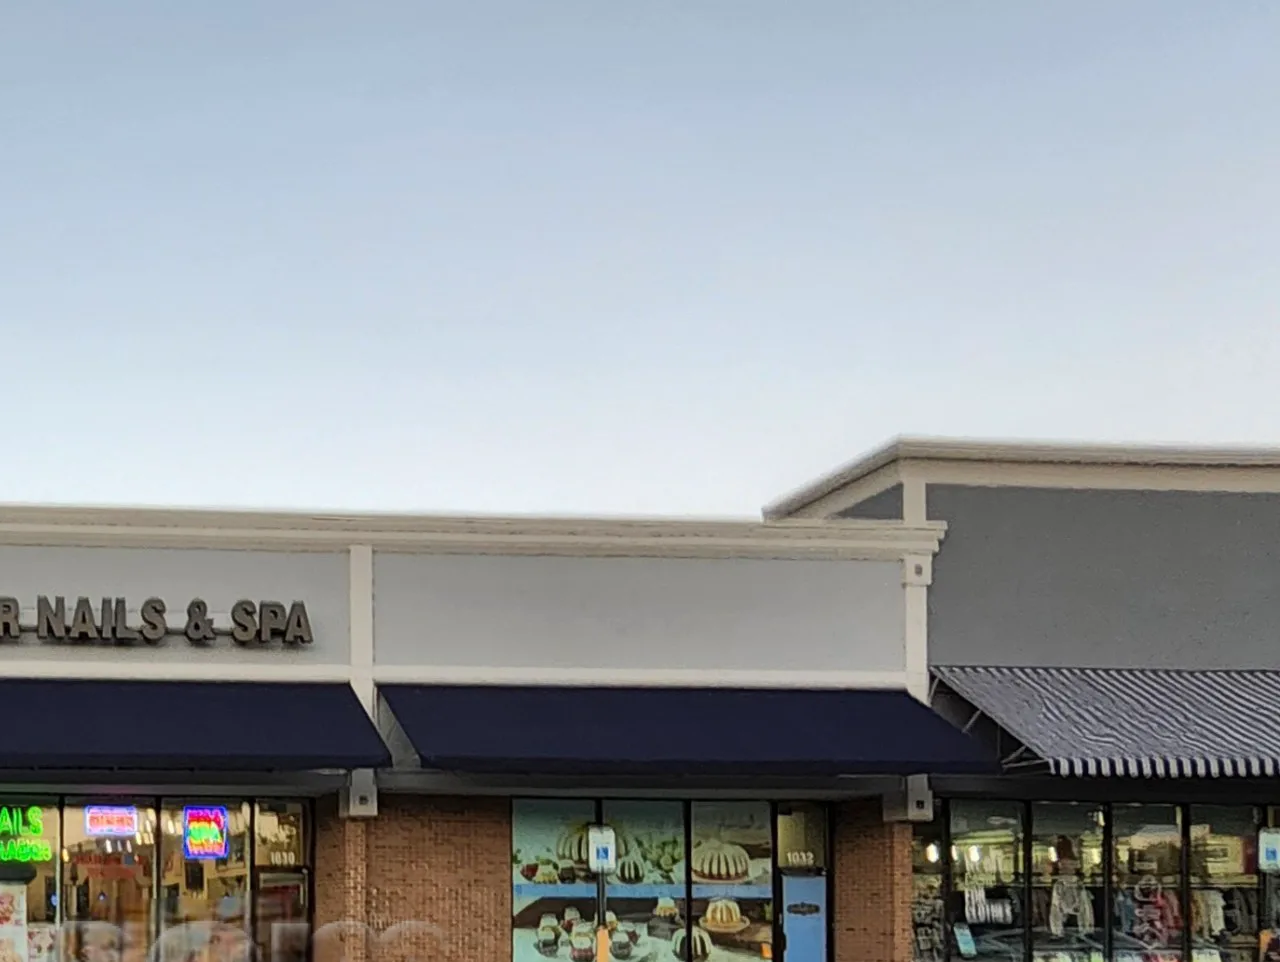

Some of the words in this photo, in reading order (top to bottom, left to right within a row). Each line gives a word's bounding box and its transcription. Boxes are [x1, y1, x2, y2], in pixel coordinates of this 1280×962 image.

[36, 595, 167, 642] NAILS
[185, 599, 216, 643] &
[230, 600, 314, 645] SPA
[787, 851, 815, 866] 1032
